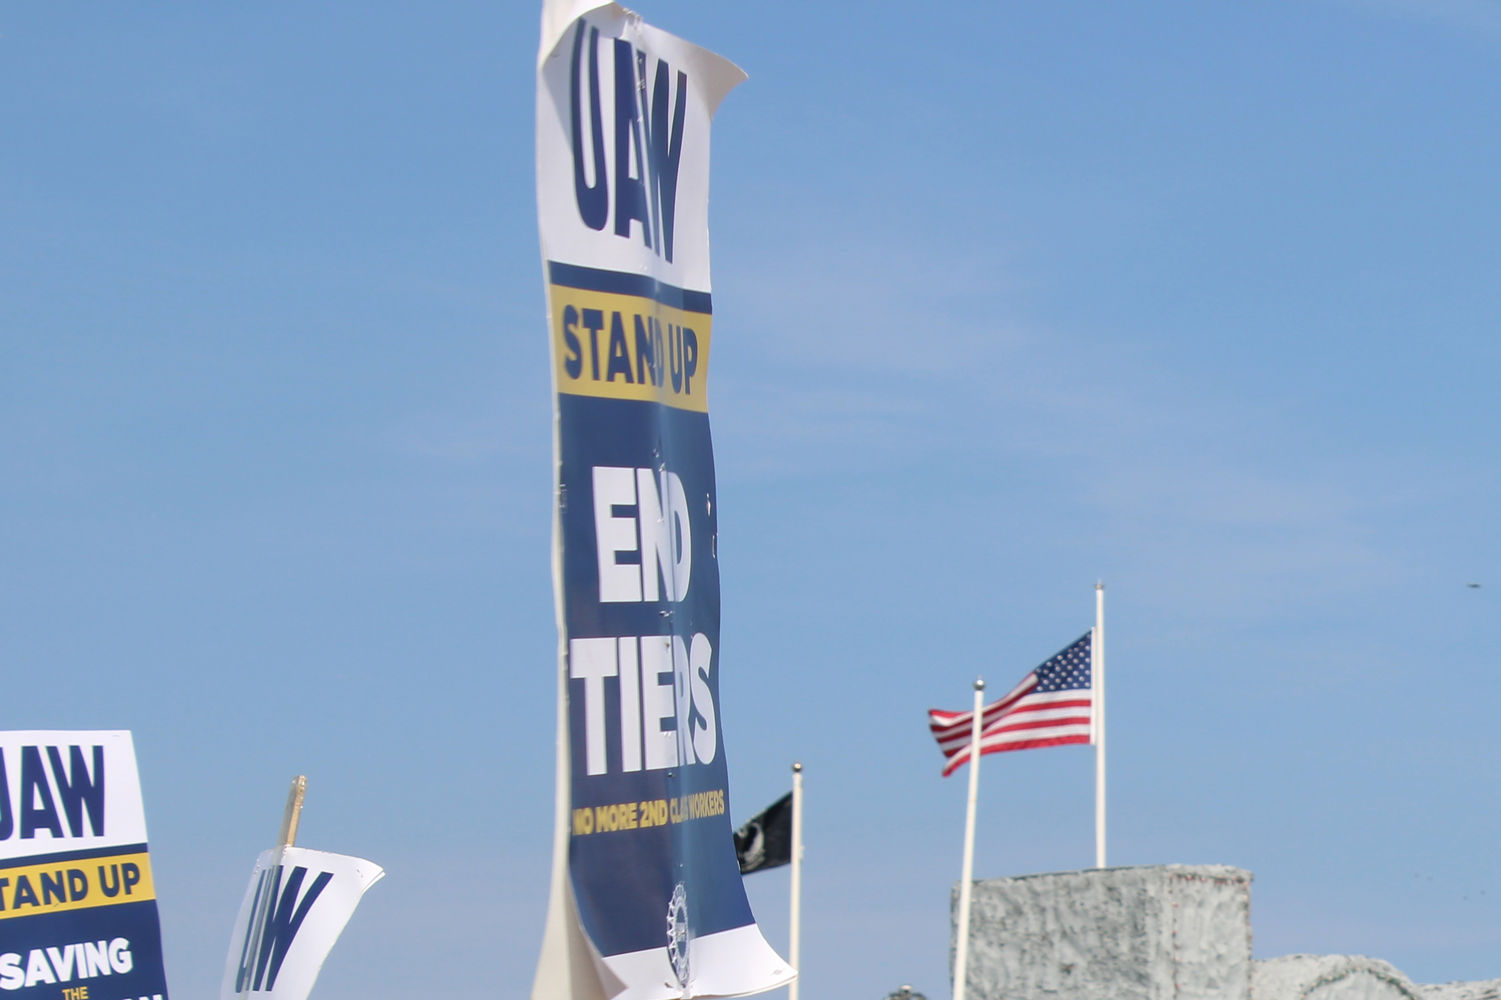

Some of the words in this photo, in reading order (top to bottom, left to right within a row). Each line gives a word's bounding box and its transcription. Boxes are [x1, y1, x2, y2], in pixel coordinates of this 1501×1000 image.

[571, 18, 687, 264] UAW
[562, 304, 665, 388] STAND
[668, 323, 698, 395] UP
[592, 466, 692, 603] END
[570, 632, 716, 776] TIERS
[573, 807, 594, 836] NO
[595, 802, 638, 833] MORE
[639, 799, 668, 828] 2ND
[688, 789, 725, 820] WORKERS
[0, 866, 89, 911] TAND
[97, 862, 141, 898] UP
[0, 937, 133, 990] SAVING
